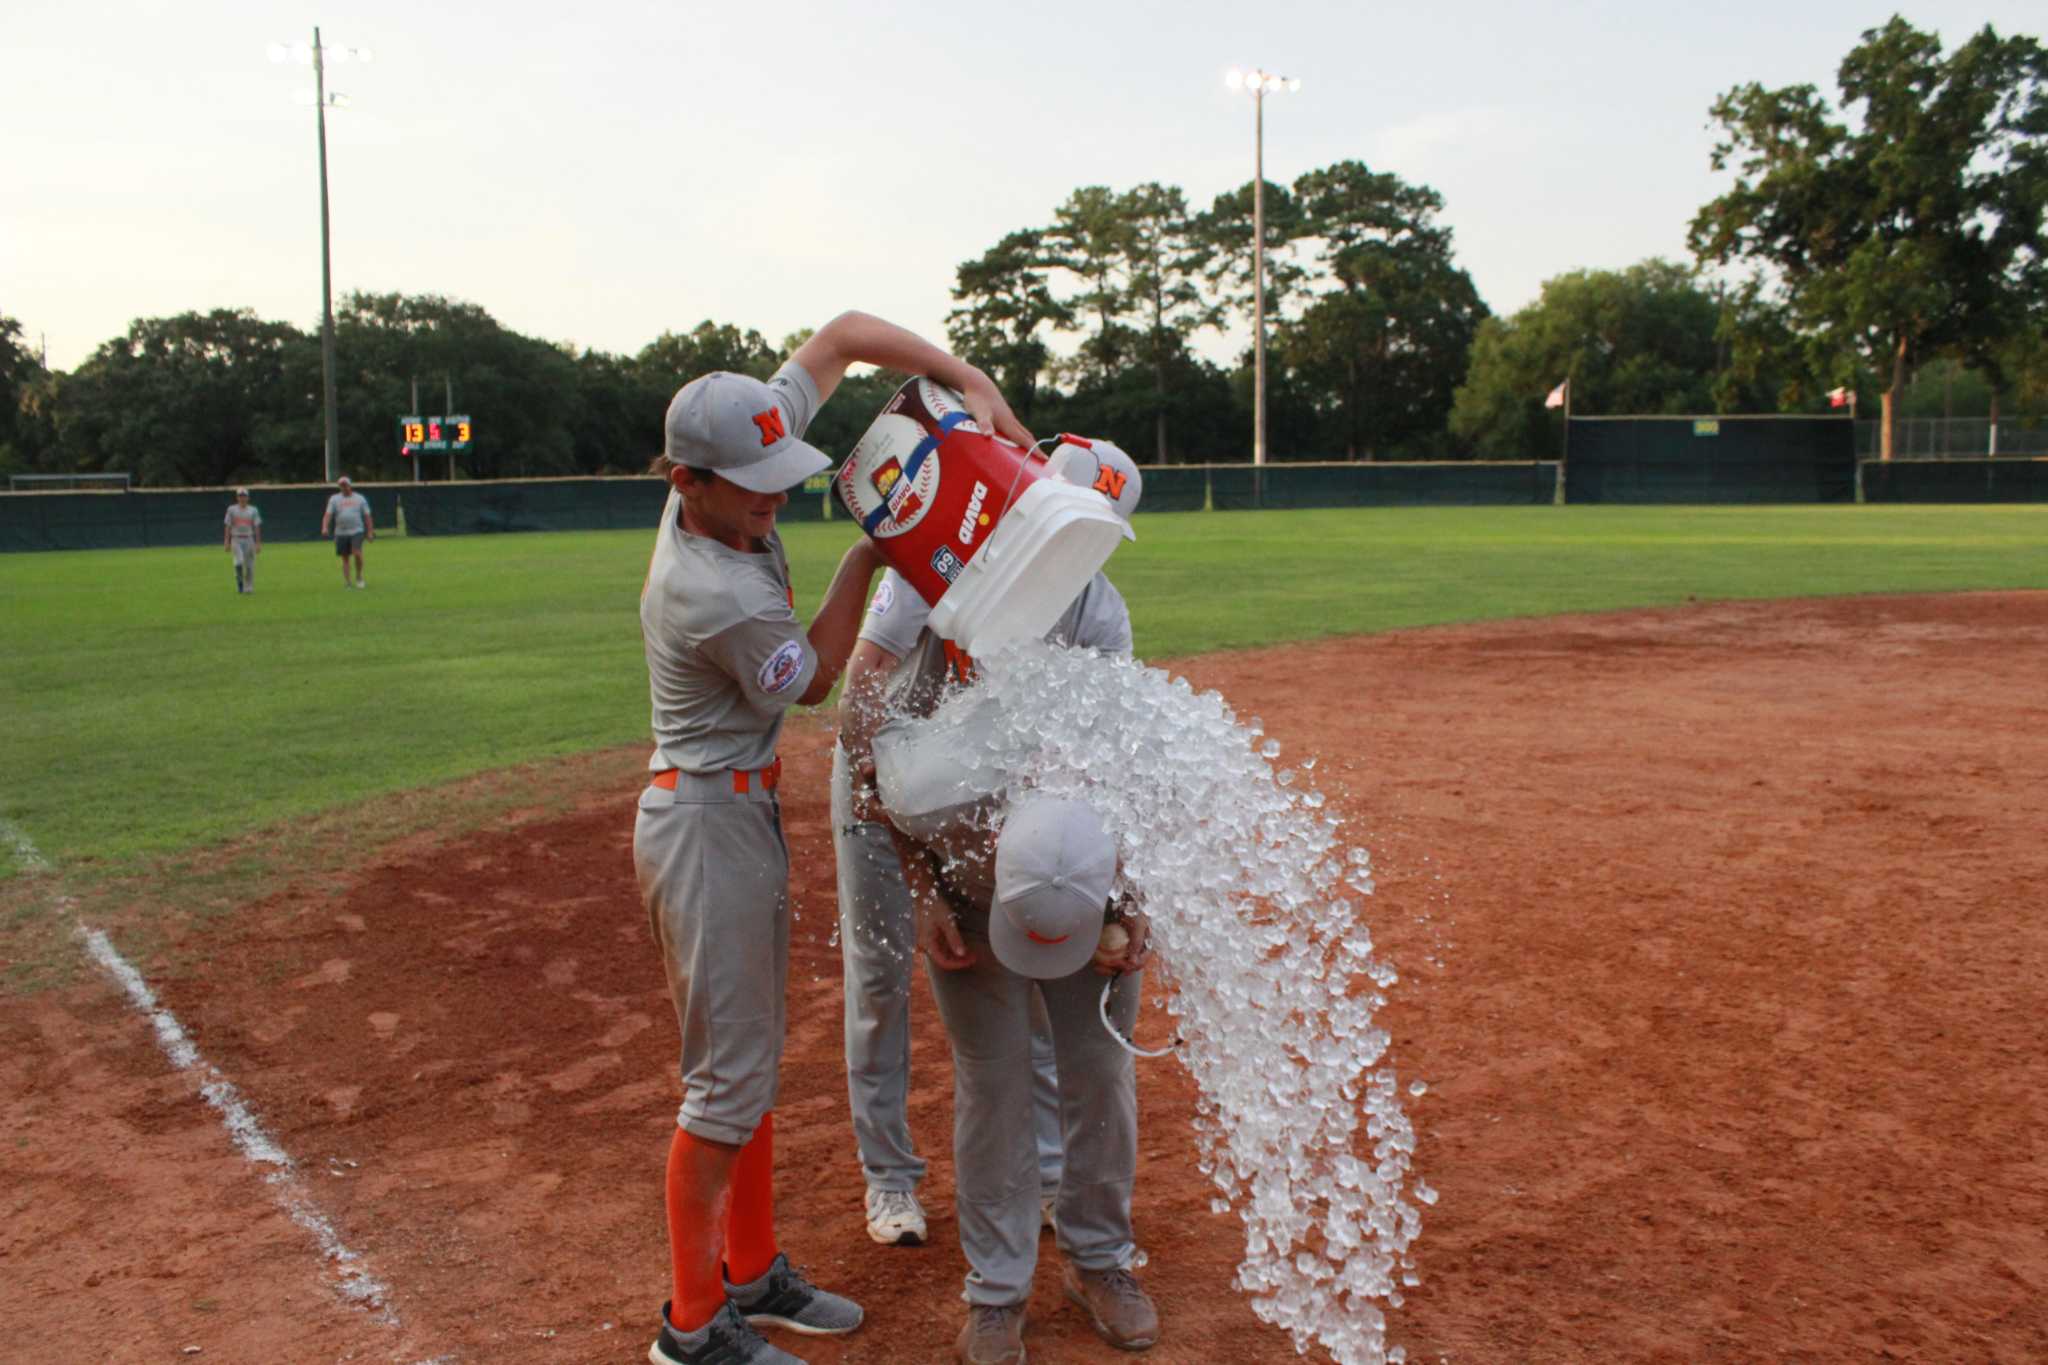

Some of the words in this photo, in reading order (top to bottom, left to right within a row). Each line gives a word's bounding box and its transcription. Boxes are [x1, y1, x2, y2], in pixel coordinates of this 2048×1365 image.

[405, 422, 424, 443] 13
[458, 422, 470, 443] 3
[752, 405, 786, 448] N
[1092, 463, 1128, 501] N
[890, 483, 911, 511] DAVID
[958, 480, 988, 545] DAVID
[936, 552, 955, 574] 60
